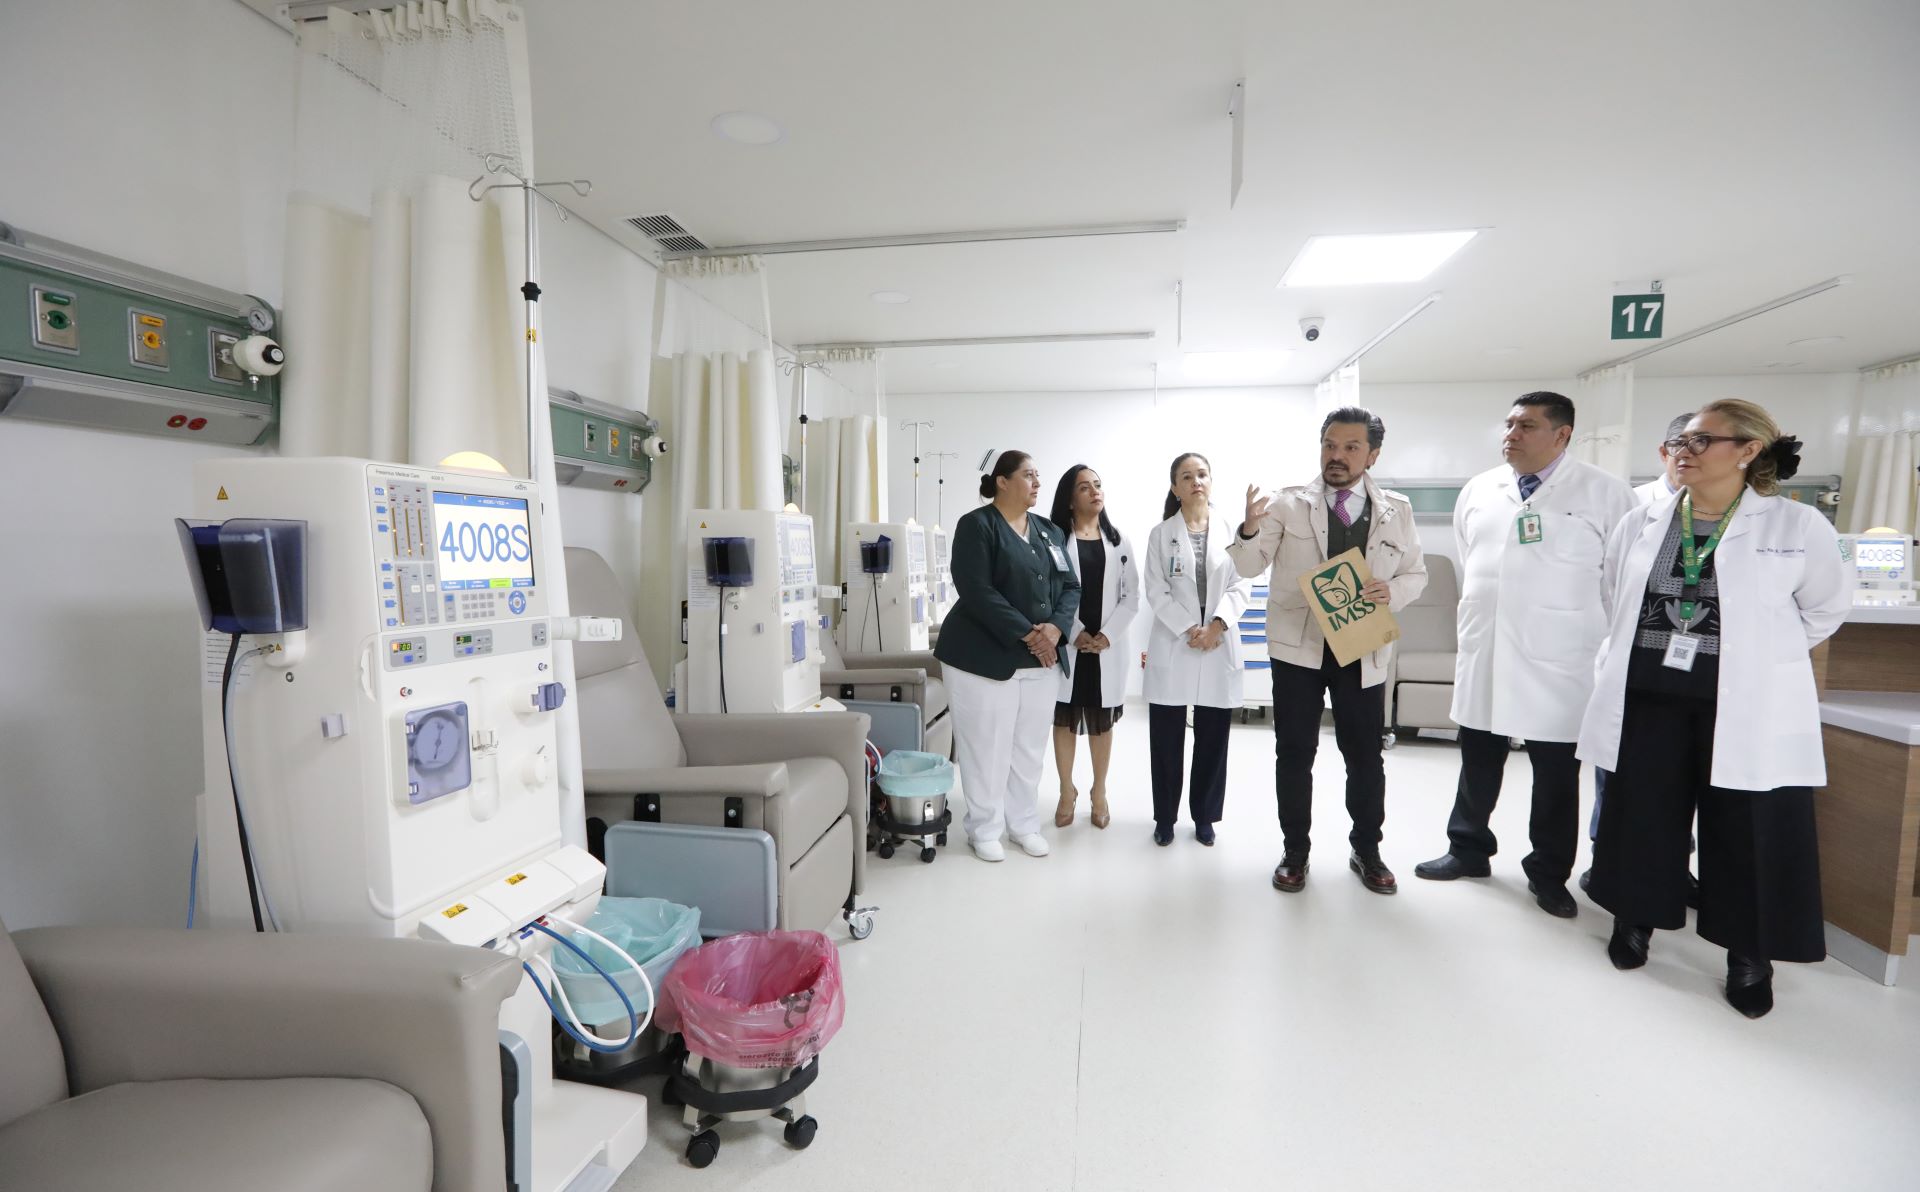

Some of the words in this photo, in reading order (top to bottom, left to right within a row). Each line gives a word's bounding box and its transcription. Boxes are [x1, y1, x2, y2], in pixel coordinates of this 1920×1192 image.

[1621, 302, 1662, 332] 17
[440, 521, 530, 563] 4008S
[1859, 549, 1904, 562] 4008S
[1328, 598, 1376, 632] IMSS
